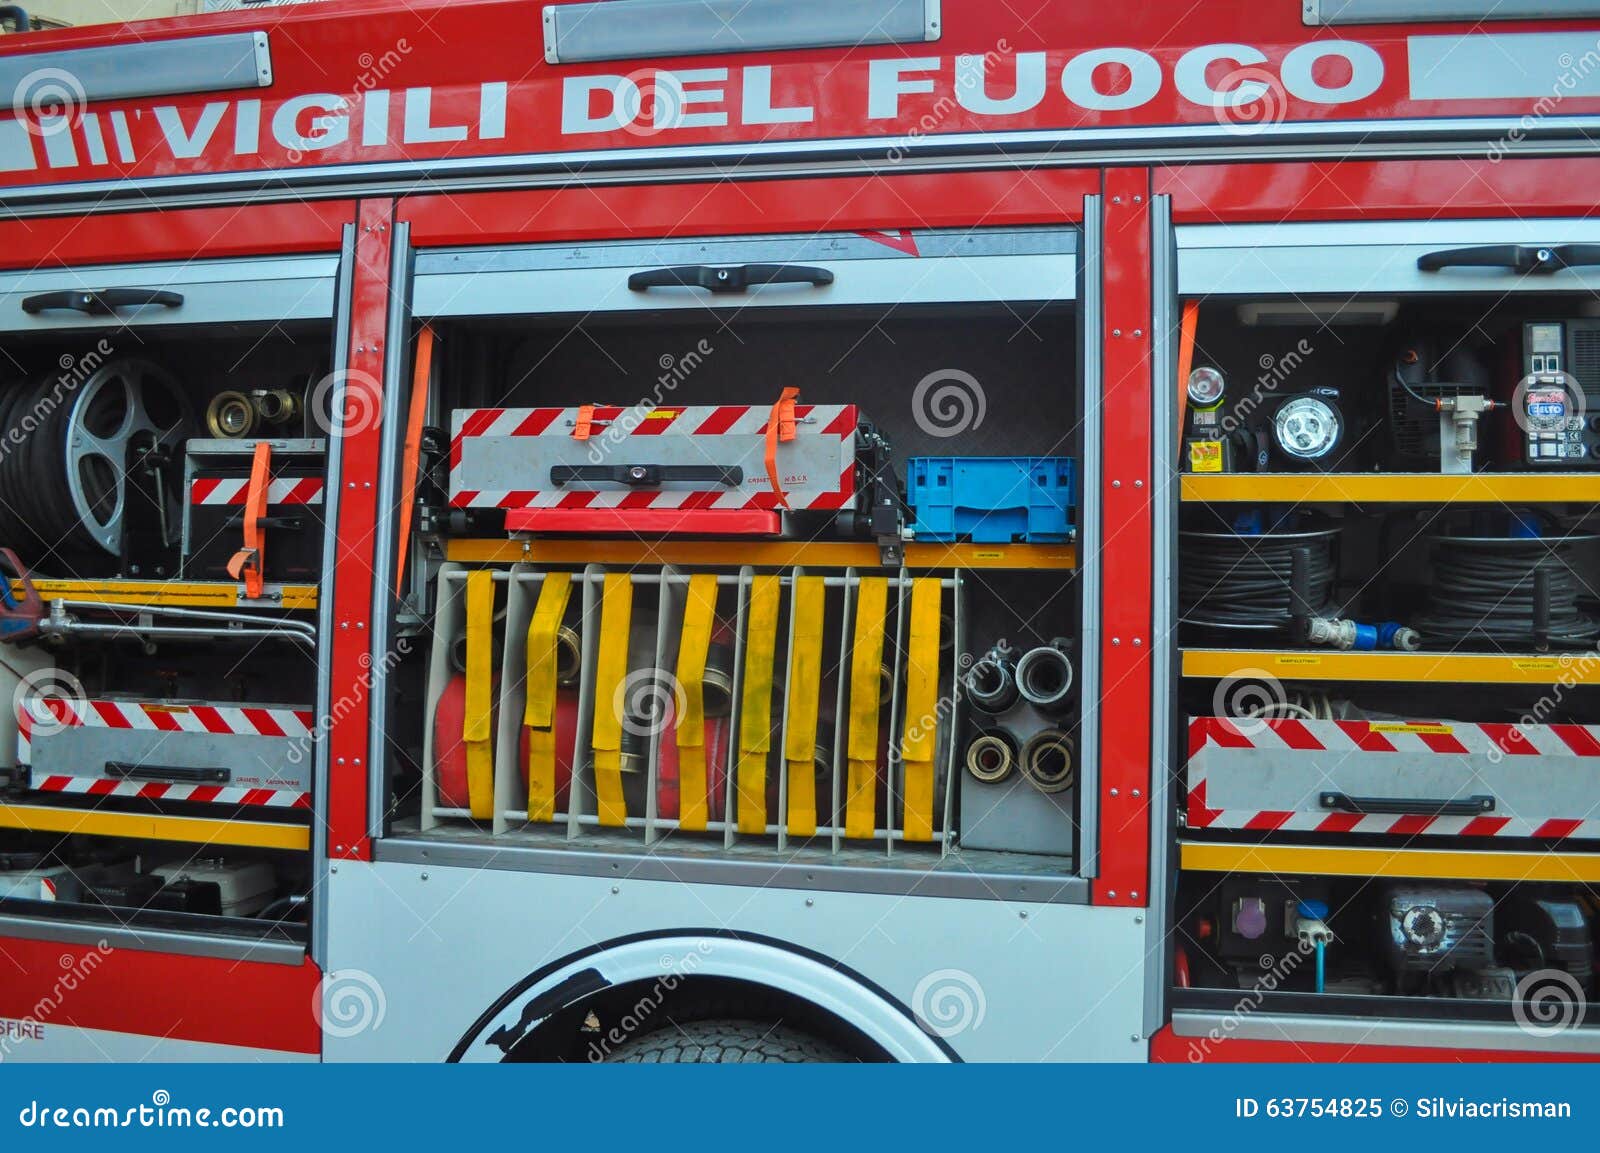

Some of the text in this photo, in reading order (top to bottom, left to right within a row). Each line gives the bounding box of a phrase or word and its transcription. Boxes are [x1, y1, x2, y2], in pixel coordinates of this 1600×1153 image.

[153, 40, 1385, 159] VIGILI DEL FUOCO
